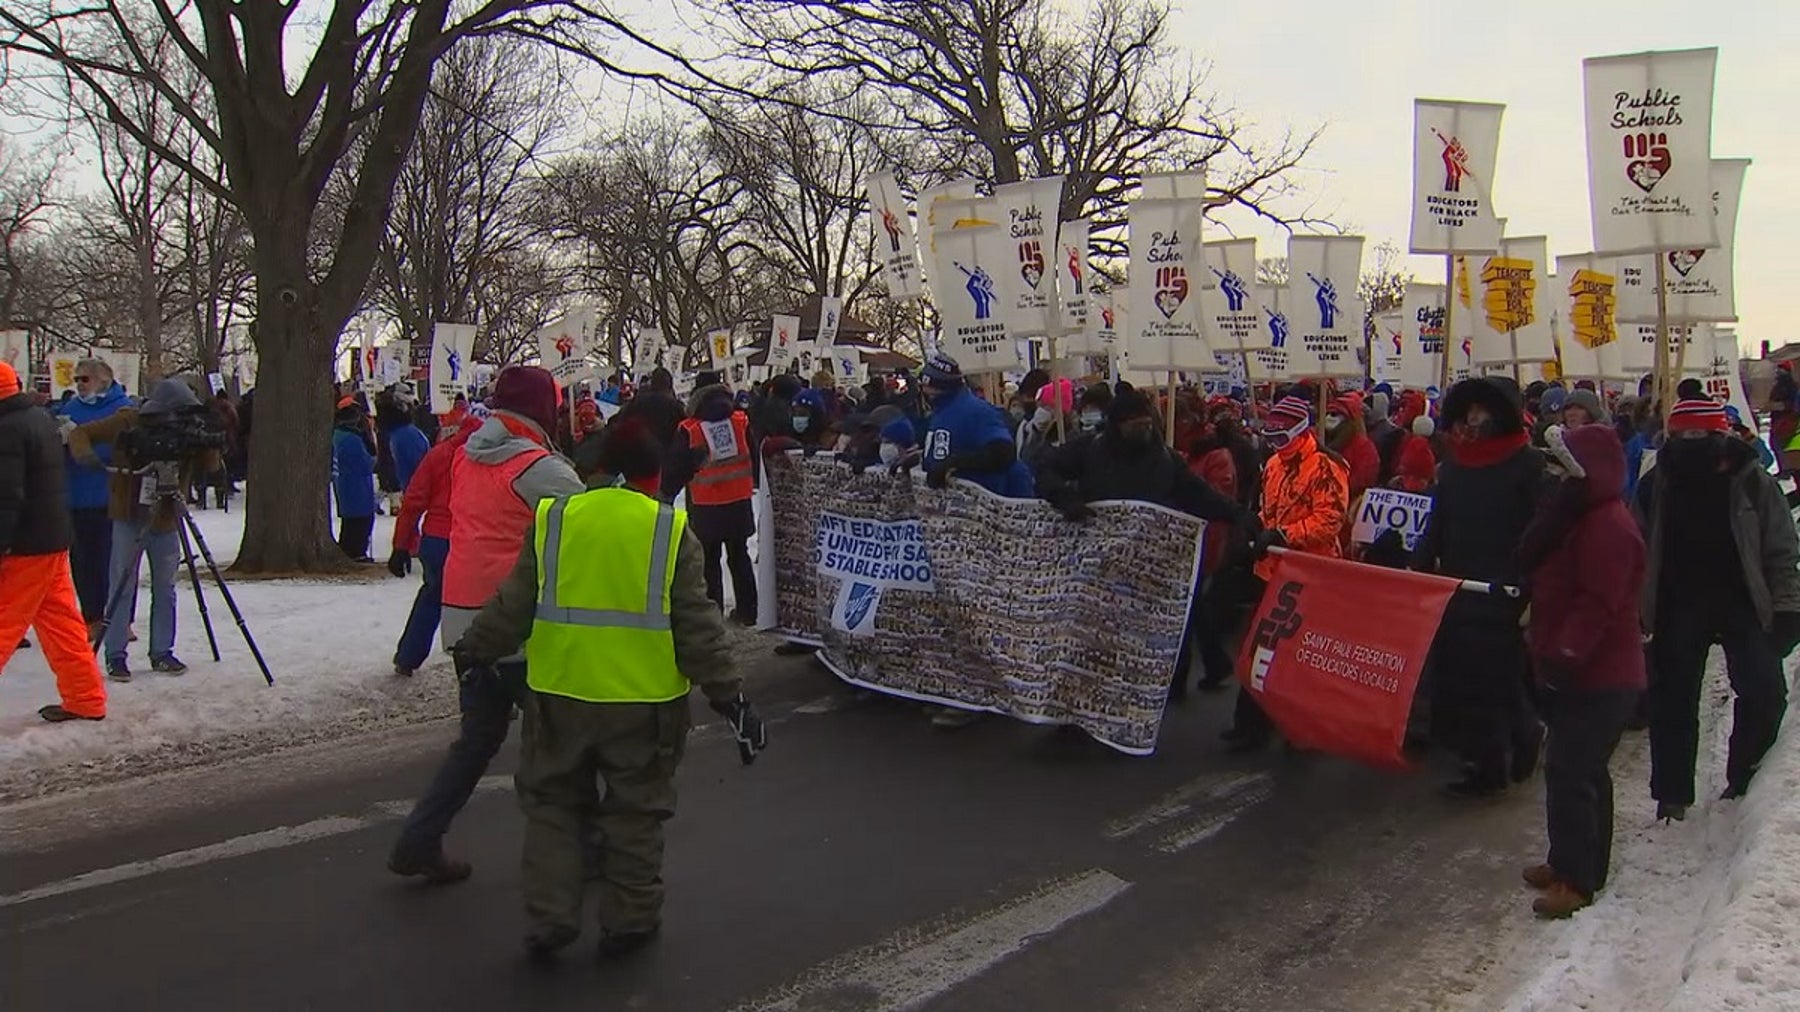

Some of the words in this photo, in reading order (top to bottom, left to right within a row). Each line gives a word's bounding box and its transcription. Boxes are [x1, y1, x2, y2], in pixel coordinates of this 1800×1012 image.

[1615, 88, 1680, 109] Public
[1610, 107, 1682, 128] Schools
[1427, 196, 1478, 207] EDUCATORS
[1429, 206, 1443, 214] FOR
[1446, 208, 1478, 217] BLACK
[1438, 218, 1463, 227] LIVES
[958, 323, 1005, 336] EDUCATORS
[962, 336, 979, 345] FOR
[981, 334, 1006, 344] BLACK
[975, 344, 997, 353] LIVES
[1369, 492, 1393, 503] THE
[1397, 494, 1428, 510] TIME
[828, 532, 883, 559] UNITED
[825, 552, 881, 579] STABLE
[1301, 631, 1332, 652] SAINT
[1331, 640, 1353, 659] PAUL
[1351, 645, 1406, 674] FEDERATION
[1296, 648, 1312, 664] OF
[1310, 653, 1359, 681] EDUCATORS
[1359, 671, 1386, 691] LOCAL
[1386, 677, 1399, 694] 28
